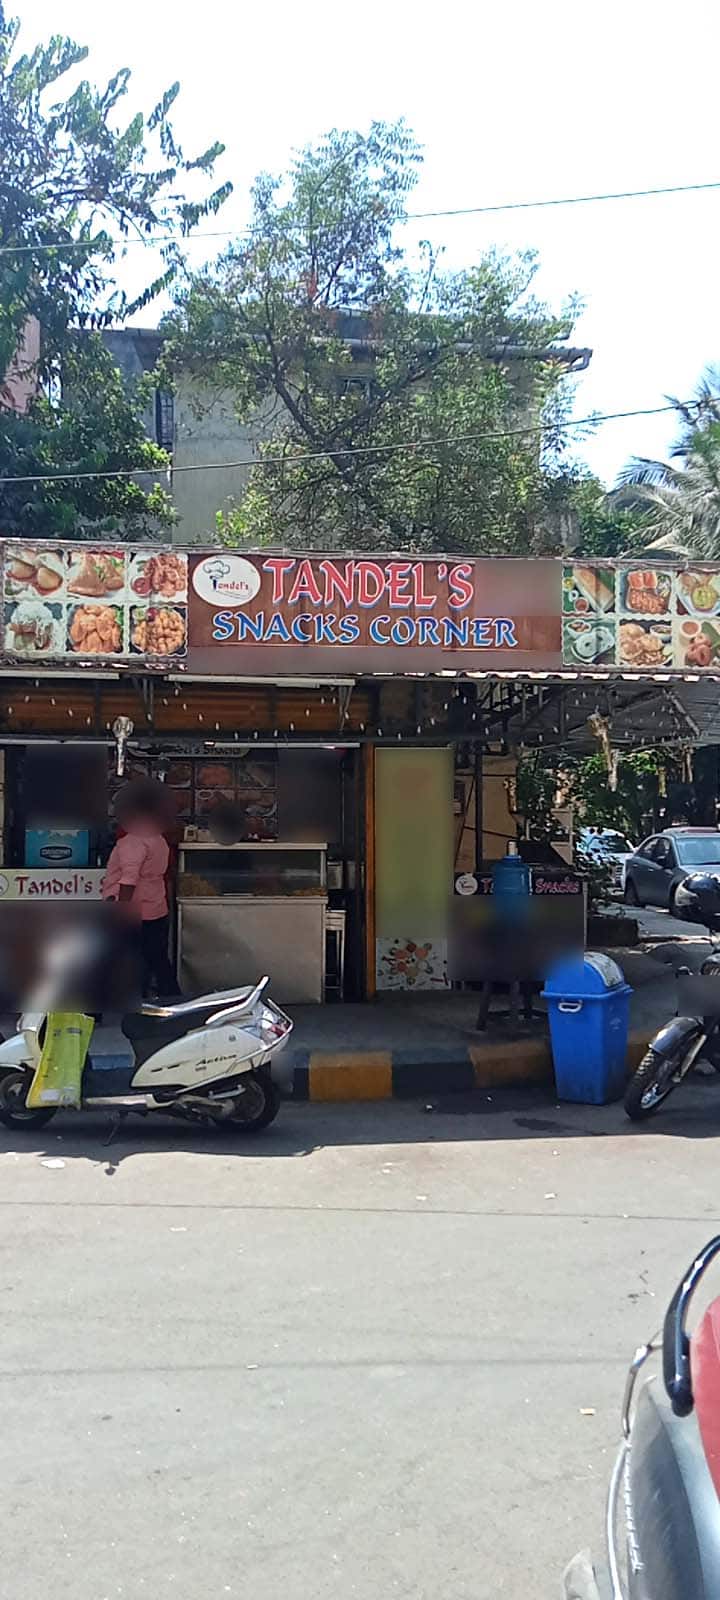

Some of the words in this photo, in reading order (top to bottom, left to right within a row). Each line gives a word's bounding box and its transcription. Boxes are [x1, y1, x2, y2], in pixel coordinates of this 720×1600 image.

[263, 558, 475, 609] TANDEL'S
[211, 611, 361, 644] SNACKS
[369, 616, 519, 648] CORNER
[14, 874, 93, 896] Tandel's
